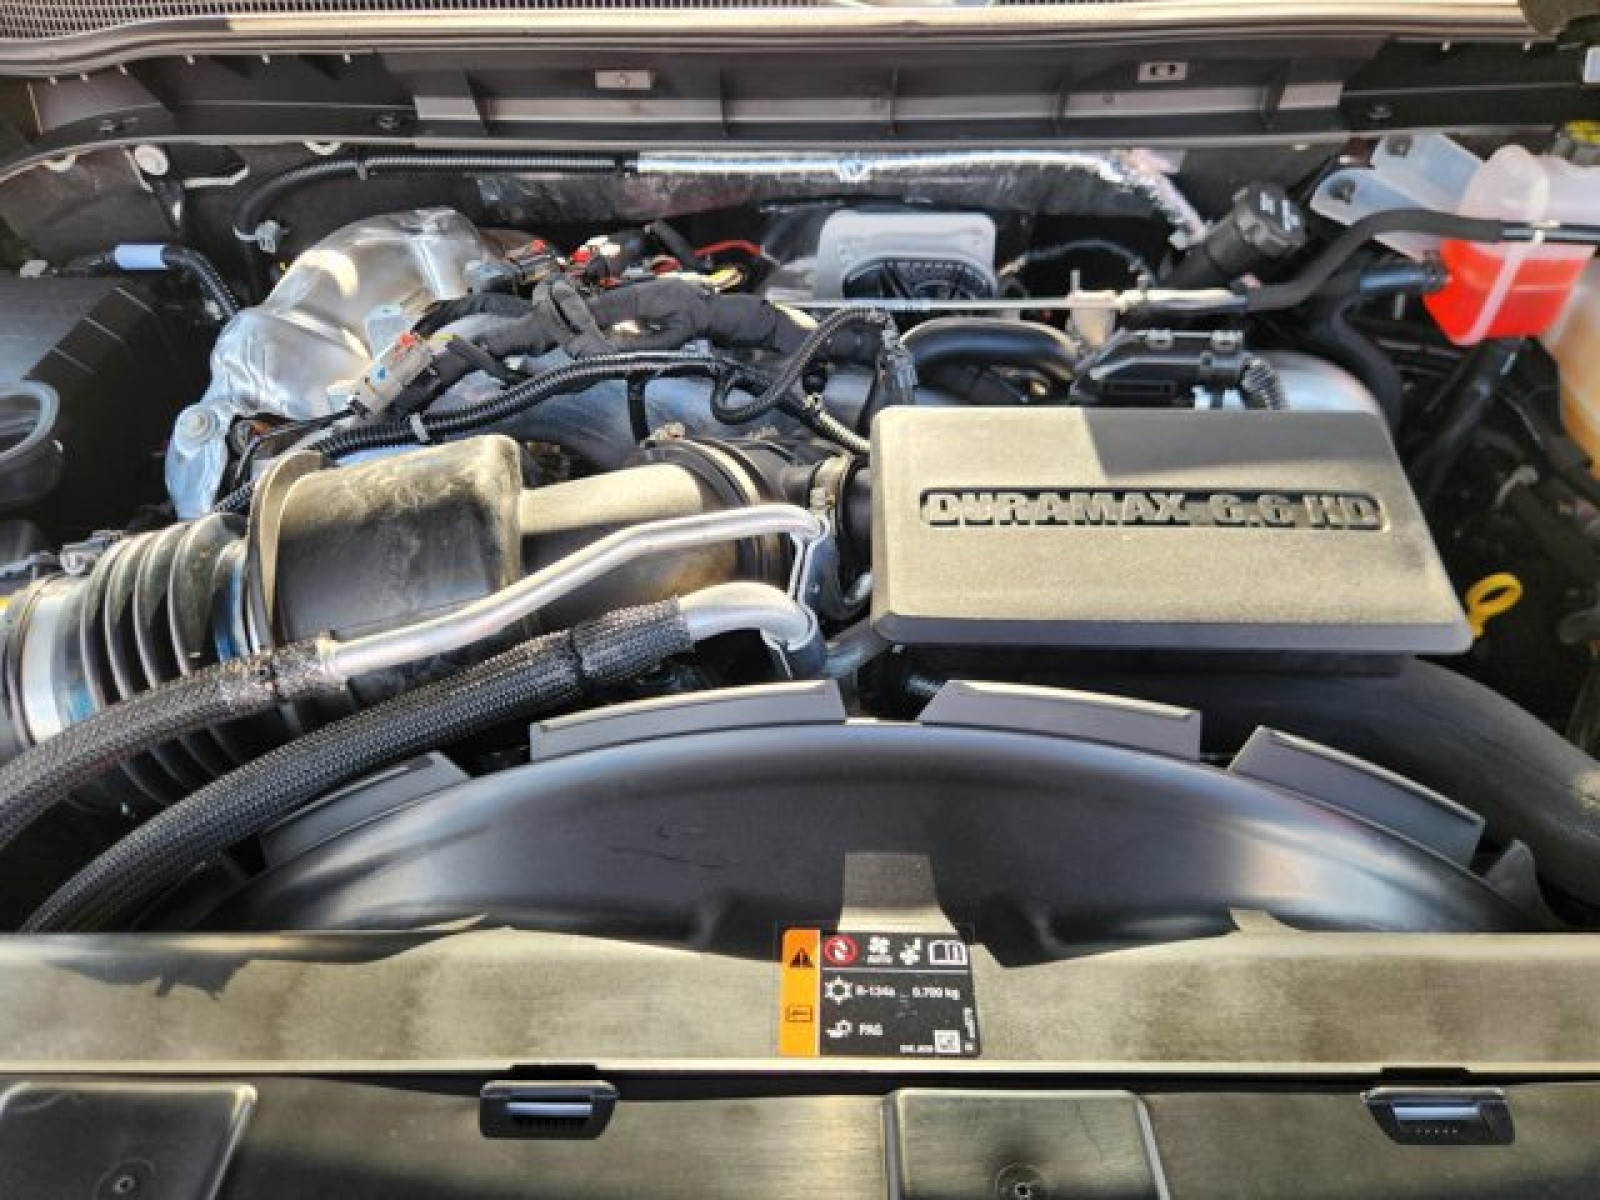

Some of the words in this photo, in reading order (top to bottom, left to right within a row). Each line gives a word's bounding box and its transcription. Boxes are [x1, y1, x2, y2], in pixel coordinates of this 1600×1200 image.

[926, 491, 1191, 527] DURAMAX
[1211, 493, 1296, 528] 6.6
[1301, 494, 1384, 531] HD
